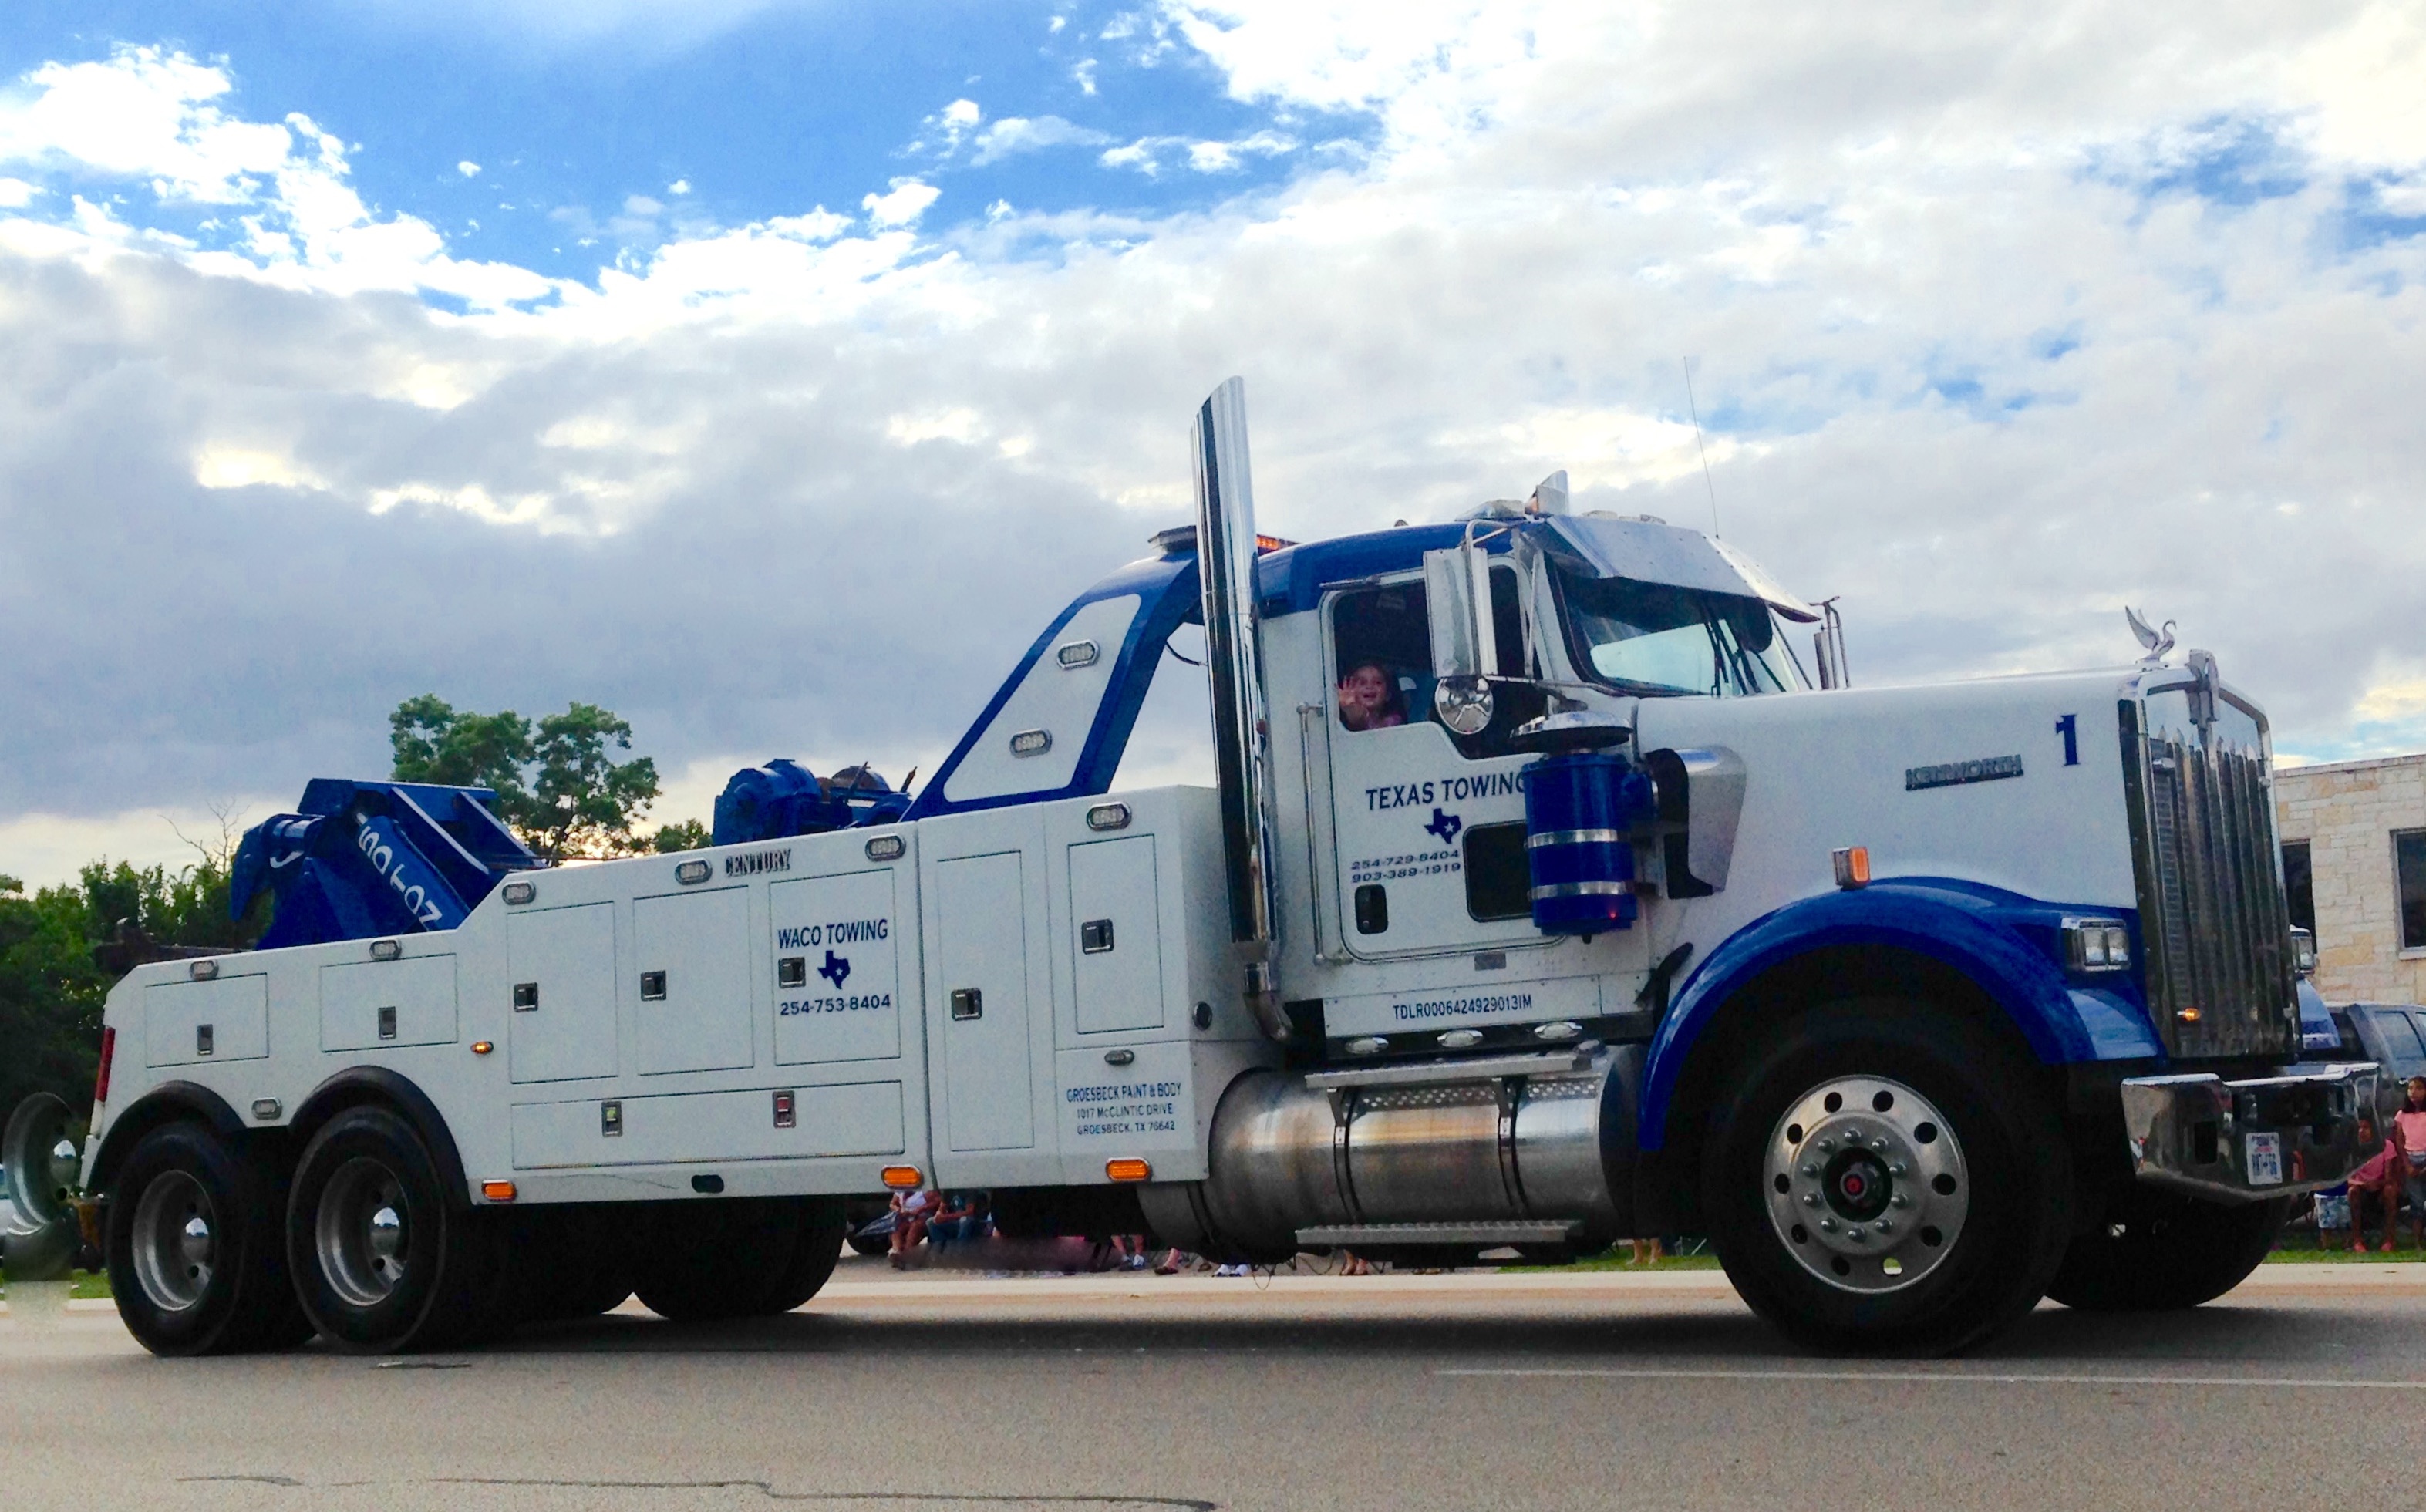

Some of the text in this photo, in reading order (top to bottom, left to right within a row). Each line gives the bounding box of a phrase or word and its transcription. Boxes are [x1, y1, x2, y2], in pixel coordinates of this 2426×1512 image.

[2056, 714, 2081, 766] 1
[1905, 754, 2023, 789] KENWORTH
[1366, 782, 1434, 810] TEXAS
[726, 848, 791, 877] CENTURY
[1351, 850, 1459, 870] 254-729-8404
[1352, 863, 1461, 883] 903-389-1919
[778, 919, 888, 948] WACO TOWING
[780, 995, 891, 1015] 254-753-8404
[1066, 1083, 1181, 1103] GROESBECK PAINT & BODY
[1077, 1103, 1173, 1119] 1017 McCLINTIC DRIVE
[1135, 1123, 1145, 1132] TX
[1149, 1121, 1174, 1131] 76642
